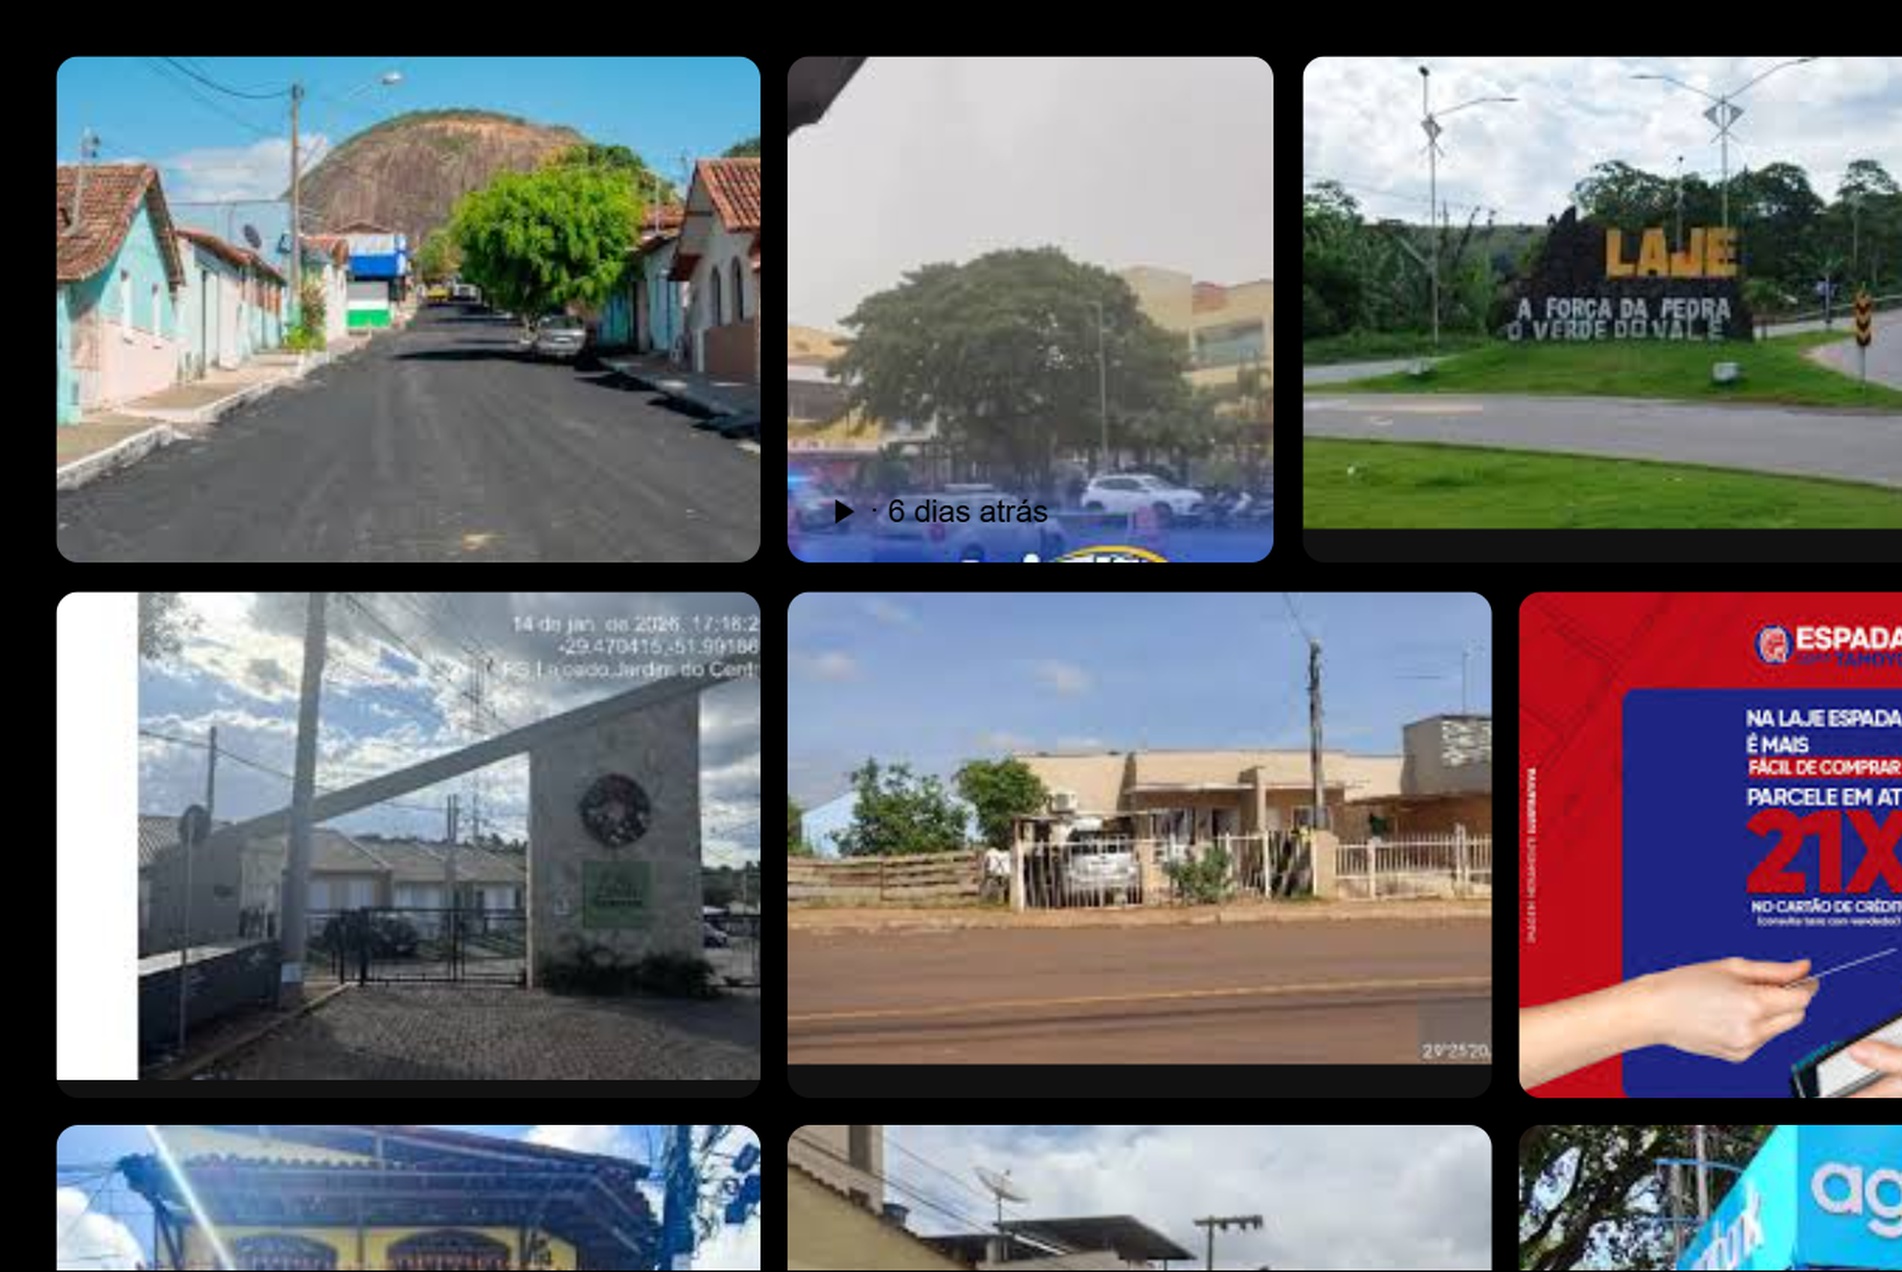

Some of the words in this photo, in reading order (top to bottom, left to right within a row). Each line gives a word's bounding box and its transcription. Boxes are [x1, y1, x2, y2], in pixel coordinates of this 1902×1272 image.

[1606, 227, 1737, 277] LAJE
[1518, 298, 1532, 319] A
[1620, 298, 1648, 319] DA
[1661, 298, 1731, 319] PEDRA
[1533, 320, 1607, 340] VERDE
[1615, 320, 1647, 339] DO
[1796, 626, 1902, 650] ESPADA
[1746, 709, 1775, 727] NA
[1779, 709, 1826, 727] LAJE
[1828, 709, 1902, 727] ESPADA
[1746, 732, 1758, 753] É
[1762, 736, 1809, 753] MAIS
[1750, 757, 1792, 775] FÁCIL
[1796, 760, 1817, 775] DE
[1820, 760, 1901, 775] COMPRAR
[1748, 788, 1838, 806] PARCELE
[1842, 788, 1874, 806] EM
[1746, 808, 1902, 893] 21X
[1752, 901, 1774, 913] NO
[1777, 898, 1831, 913] CARTÃO
[1835, 901, 1853, 913] DE
